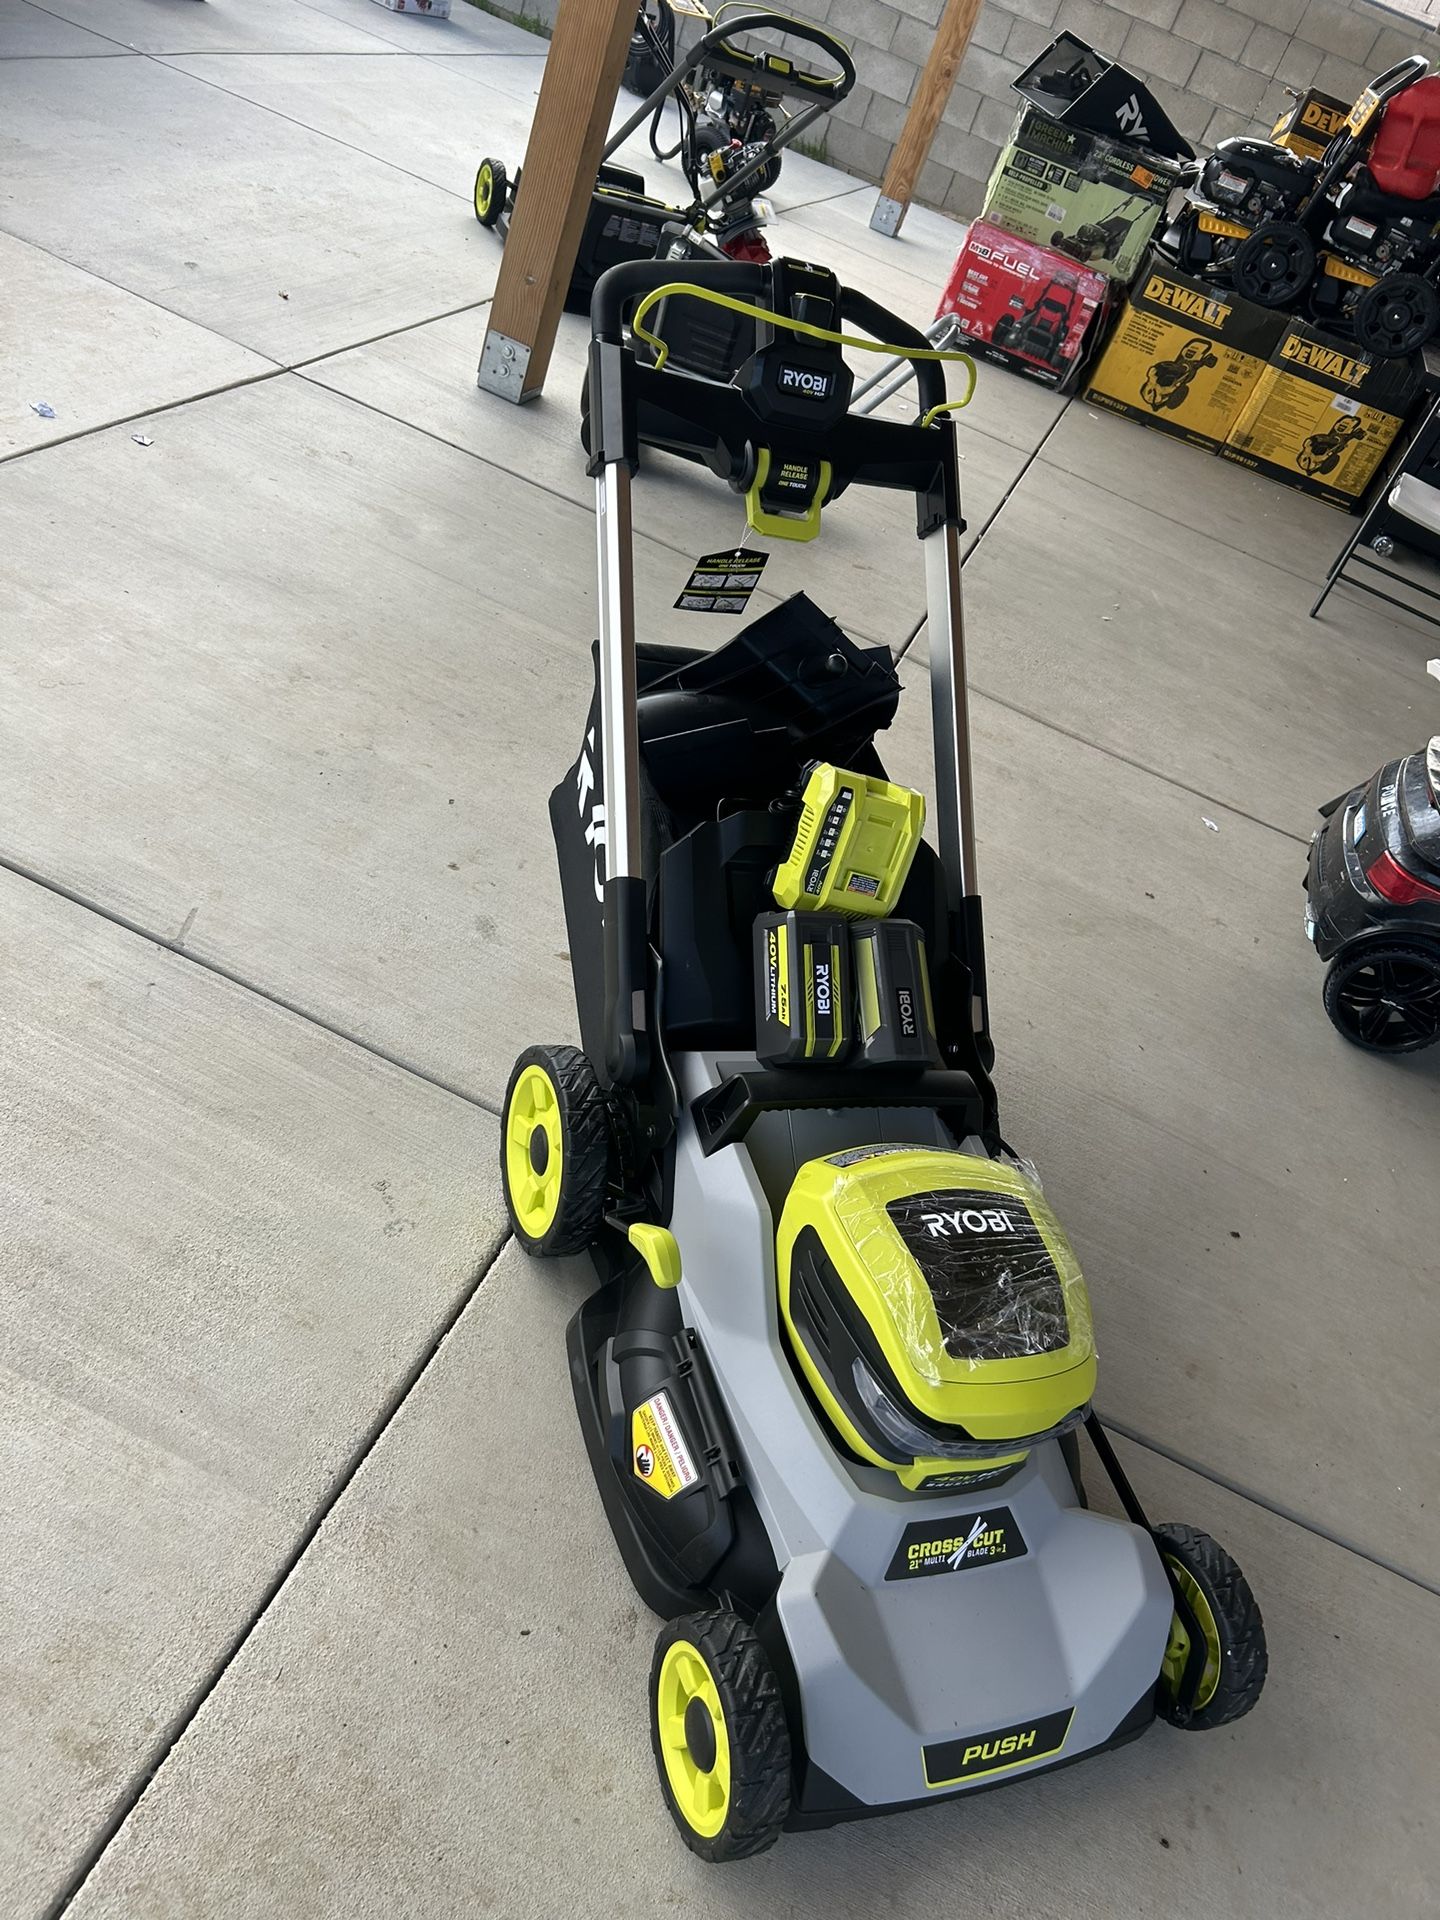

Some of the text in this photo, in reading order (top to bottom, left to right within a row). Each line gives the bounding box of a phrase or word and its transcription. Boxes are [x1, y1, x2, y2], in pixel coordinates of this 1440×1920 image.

[1030, 129, 1074, 153] MACHINE
[1035, 120, 1068, 140] GREEN
[1103, 153, 1134, 172] CORDLESS
[1151, 173, 1171, 186] OWER
[969, 243, 989, 256] M18
[989, 252, 1041, 280] FUEL
[1145, 277, 1232, 327] DEWALT
[1282, 336, 1370, 385] DEWALT
[783, 369, 827, 392] RYOBI
[780, 470, 808, 481] RELEASE
[783, 463, 808, 474] HANDLE
[778, 480, 807, 489] ONE TOUCH
[806, 869, 819, 892] RYOBI
[816, 964, 831, 1015] RYOBI
[899, 990, 915, 1035] RYOBI
[921, 1210, 1015, 1238] RYOBI
[654, 1397, 668, 1424] DANGER
[664, 1424, 680, 1452] DANGER
[676, 1454, 692, 1482] PELIGRO
[907, 1529, 1005, 1560] CROSS CUT
[909, 1560, 923, 1570] 21"
[923, 1555, 946, 1566] MULTI
[967, 1547, 989, 1558] BLADE
[962, 1730, 1037, 1765] PUSH
